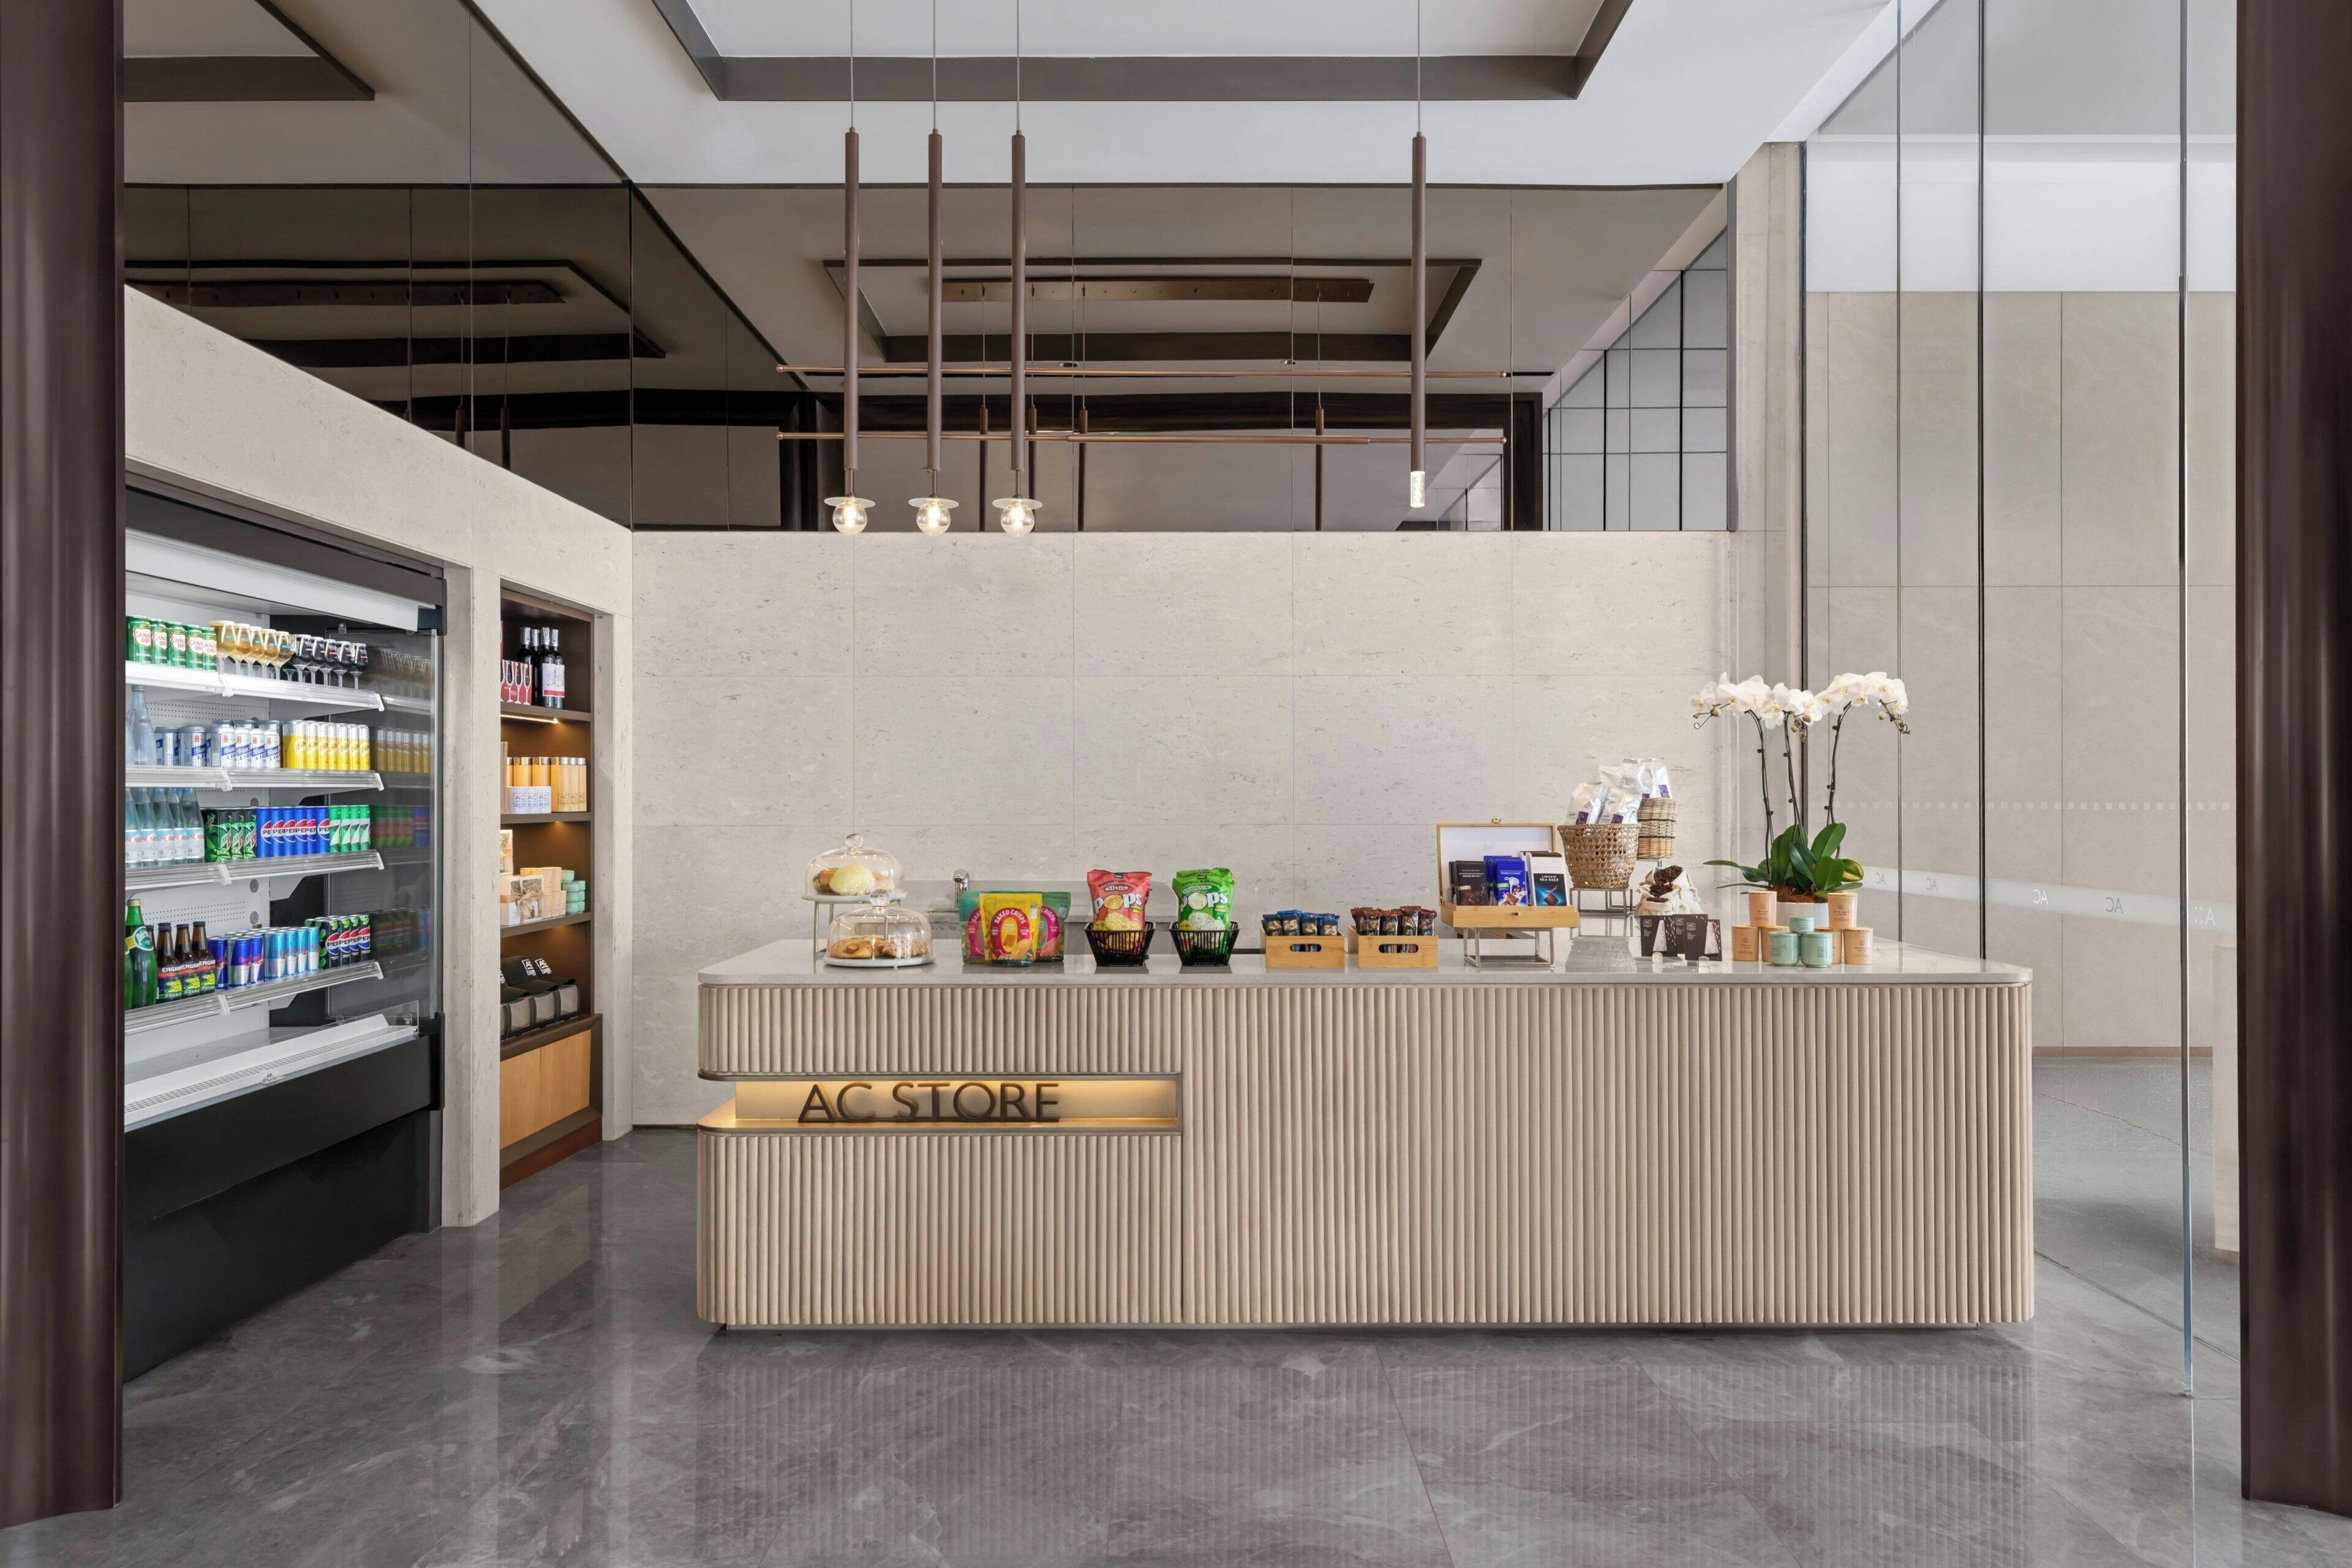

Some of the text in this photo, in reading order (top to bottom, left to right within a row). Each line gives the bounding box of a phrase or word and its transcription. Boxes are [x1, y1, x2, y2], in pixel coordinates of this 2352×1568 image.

[994, 910, 1010, 924] BAKED
[1011, 909, 1027, 924] CRISPS
[798, 1082, 1060, 1123] AC STORE
